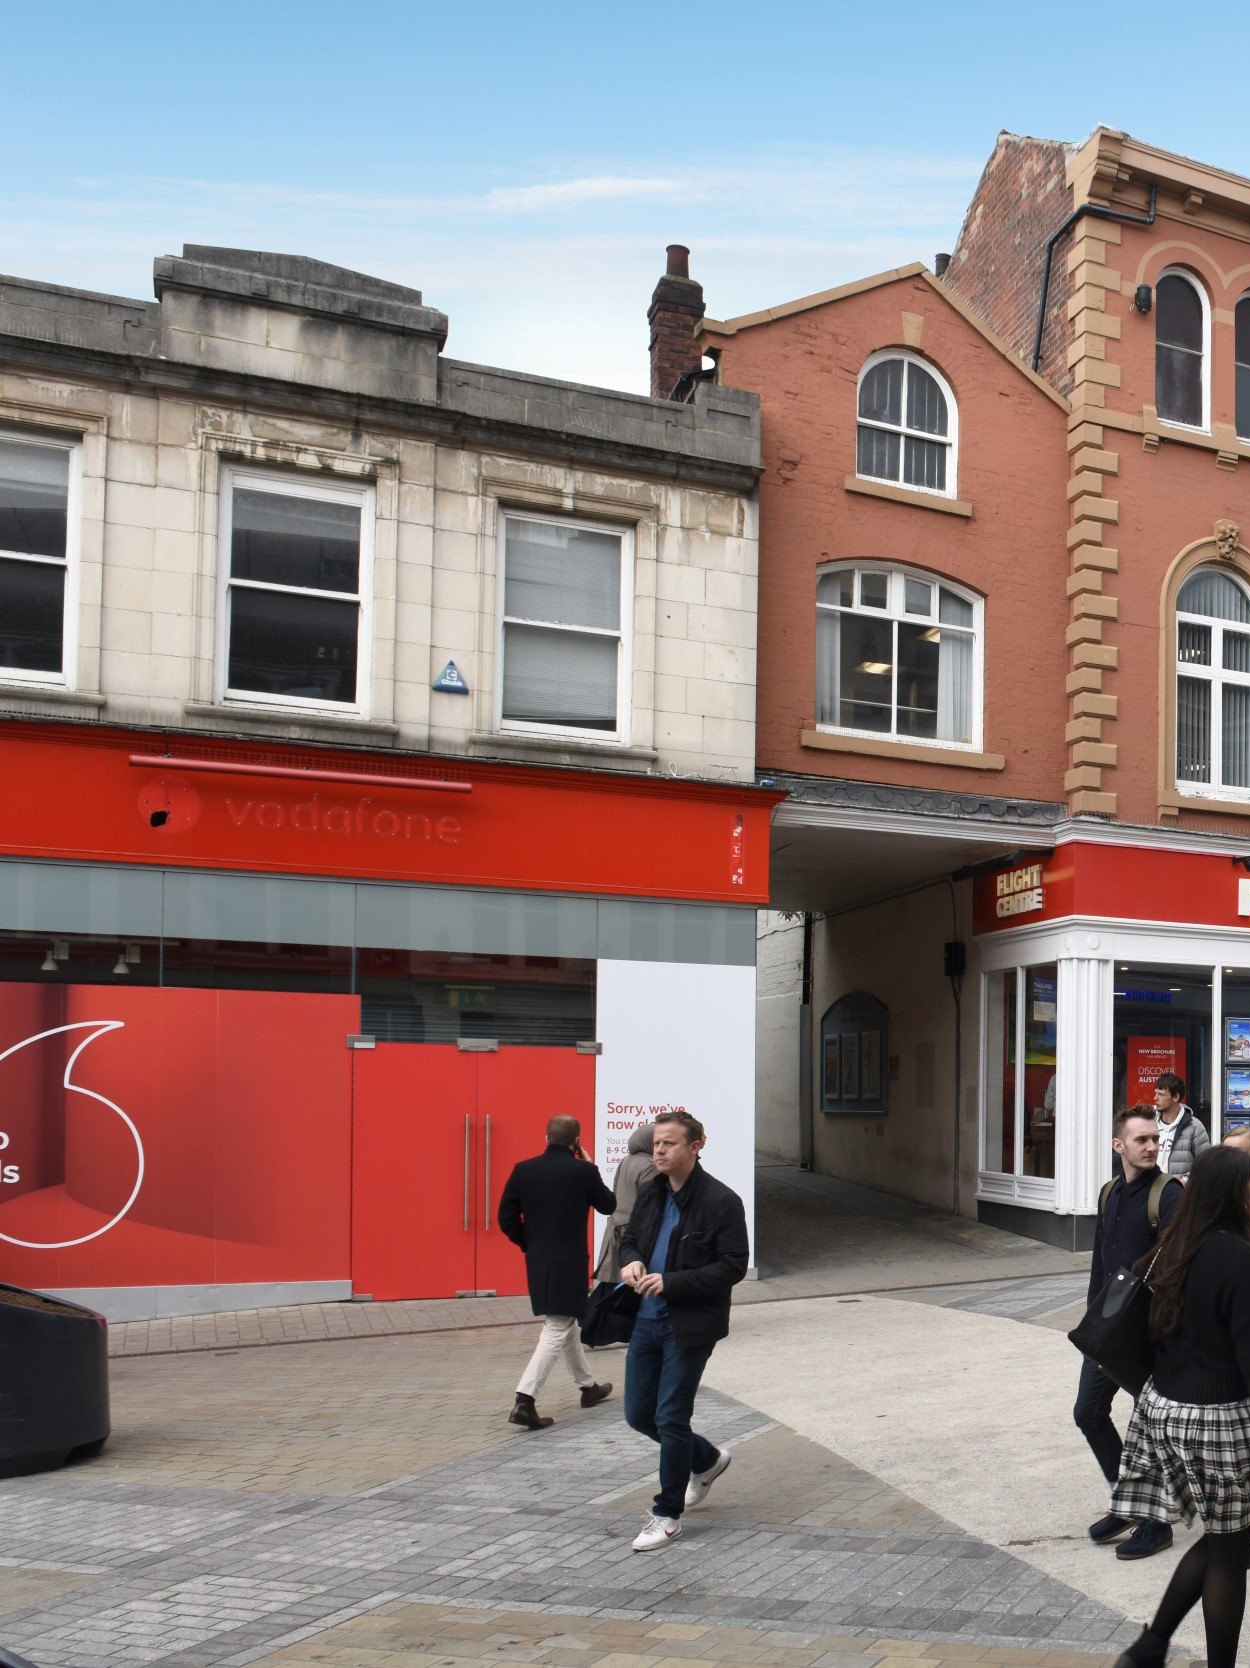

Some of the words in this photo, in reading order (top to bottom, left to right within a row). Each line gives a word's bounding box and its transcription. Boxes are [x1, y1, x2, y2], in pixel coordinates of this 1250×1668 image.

[226, 791, 463, 843] vodafone
[997, 864, 1042, 896] FLIGHT
[996, 888, 1042, 917] CENTRE
[1139, 1066, 1175, 1075] DISCOVER
[607, 1102, 645, 1116] Sorry,
[649, 1103, 686, 1114] we've
[607, 1121, 634, 1129] now
[606, 1146, 619, 1154] 8-9
